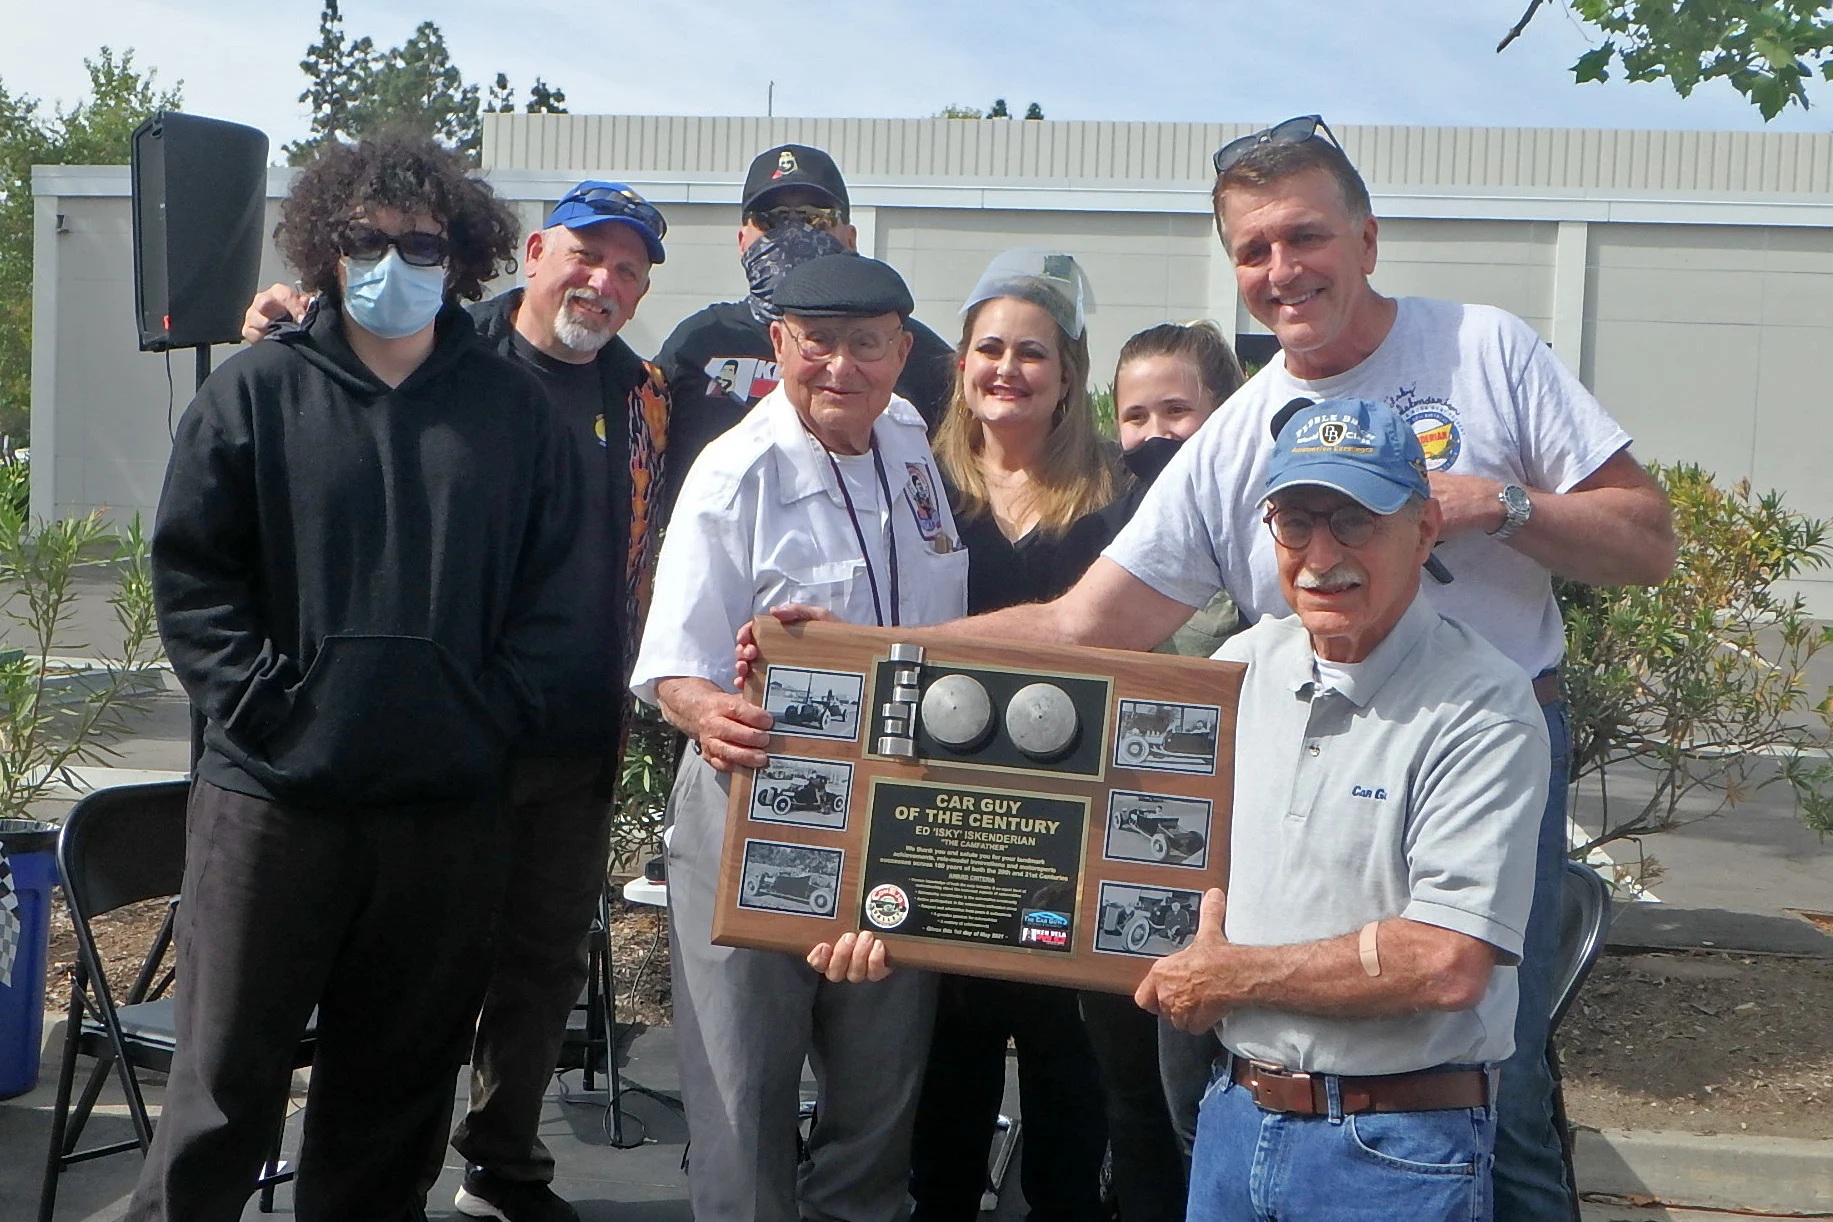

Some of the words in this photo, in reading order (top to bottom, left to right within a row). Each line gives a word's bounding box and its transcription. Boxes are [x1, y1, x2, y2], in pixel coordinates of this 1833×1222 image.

[936, 794, 974, 810] CAR
[980, 799, 1022, 814] GUY
[894, 806, 920, 820] OF
[925, 809, 963, 825] THE
[968, 813, 1060, 834] CENTURY
[915, 826, 930, 835] ED
[964, 830, 1036, 846] ISKENDERIAN
[916, 846, 933, 854] thank
[959, 850, 978, 858] salute
[1001, 854, 1016, 862] your
[1017, 855, 1045, 864] landmark
[946, 863, 963, 871] years
[963, 864, 971, 872] of
[971, 865, 985, 873] both
[1012, 869, 1024, 877] and
[1006, 862, 1019, 870] and
